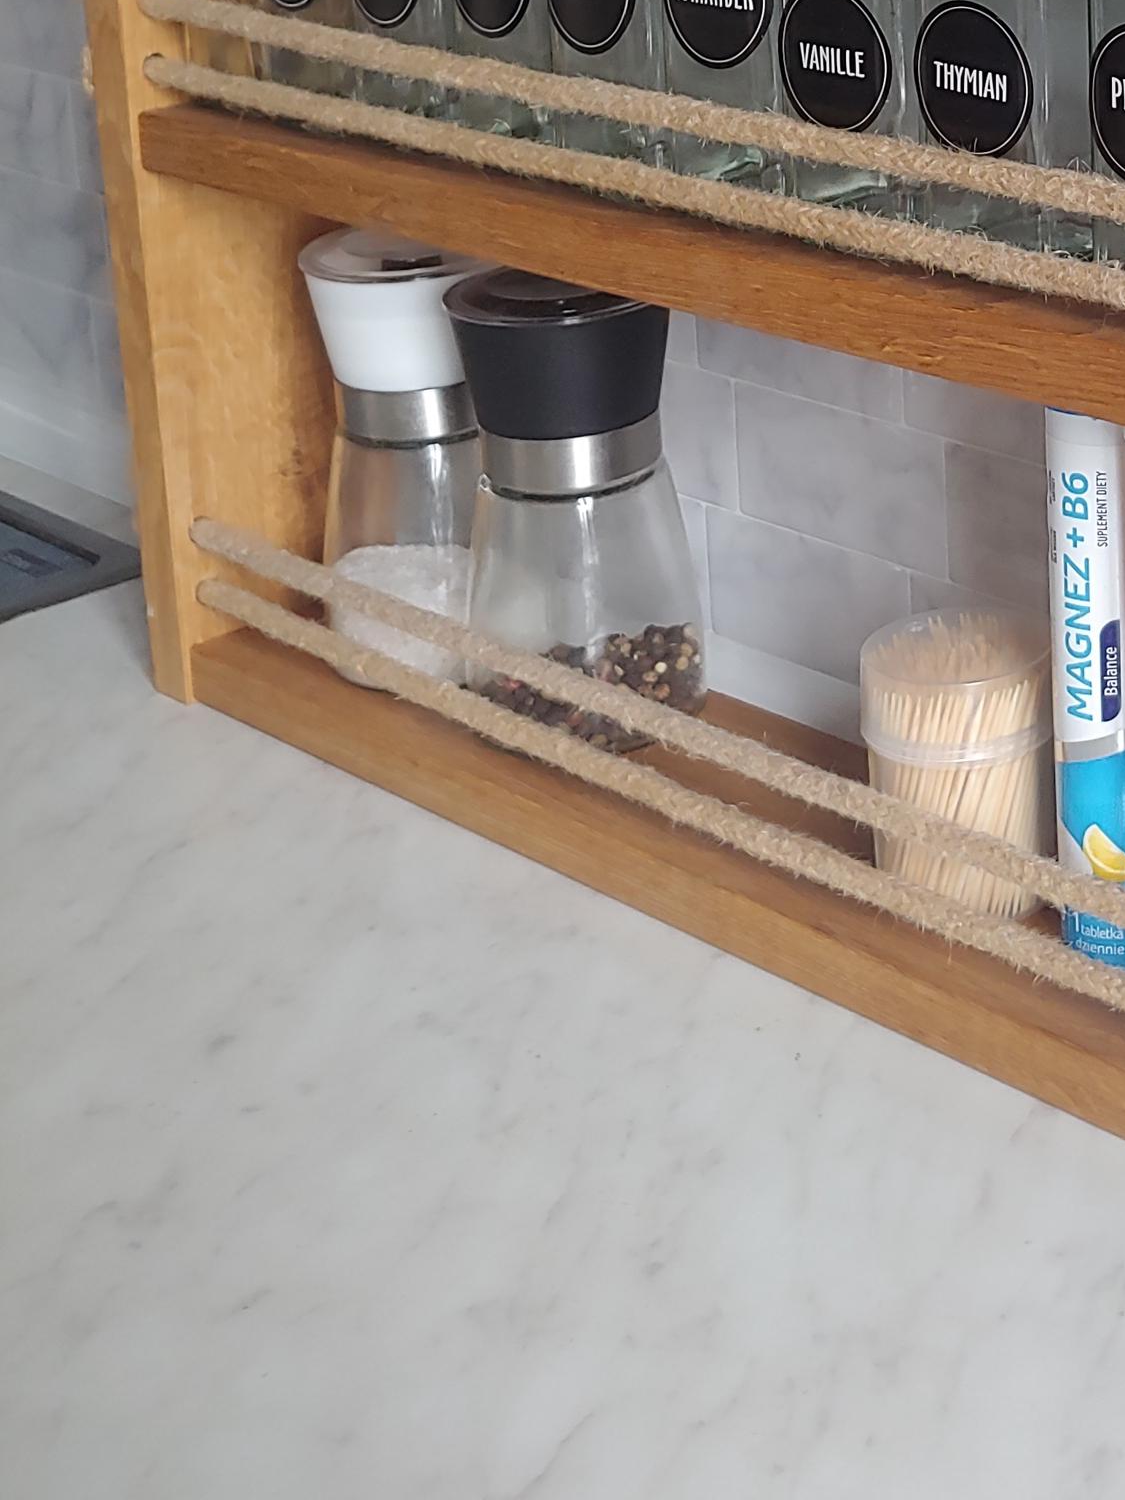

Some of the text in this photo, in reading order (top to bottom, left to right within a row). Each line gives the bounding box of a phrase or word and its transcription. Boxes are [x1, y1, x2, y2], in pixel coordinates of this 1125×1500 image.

[800, 41, 866, 79] VANILLE
[933, 60, 1008, 103] THYMIAN
[1061, 471, 1089, 520] B6
[1095, 471, 1108, 548] SUPLEMENT DIETY
[1063, 553, 1094, 721] MAGNEZ
[1104, 647, 1119, 697] Balance
[1075, 937, 1125, 956] dziennie
[1080, 924, 1125, 940] tabletka
